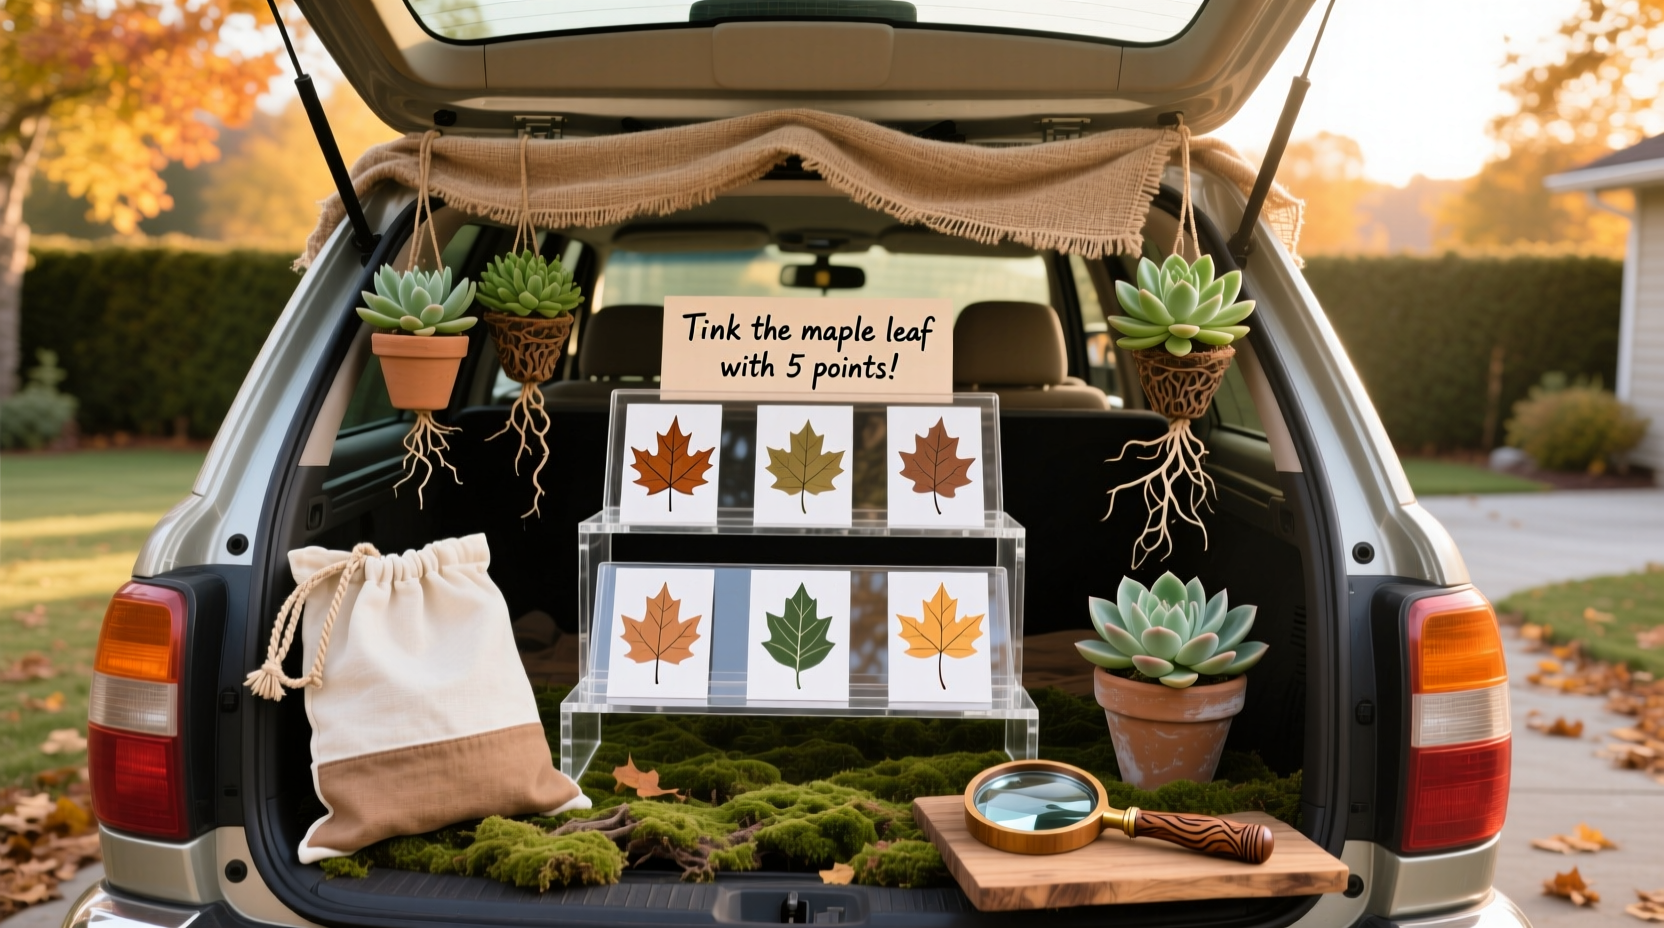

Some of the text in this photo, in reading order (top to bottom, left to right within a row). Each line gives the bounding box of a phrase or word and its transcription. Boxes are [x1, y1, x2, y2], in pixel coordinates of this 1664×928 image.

[682, 312, 936, 353] Tink the maple leaf
[720, 350, 899, 391] with 5 points!
